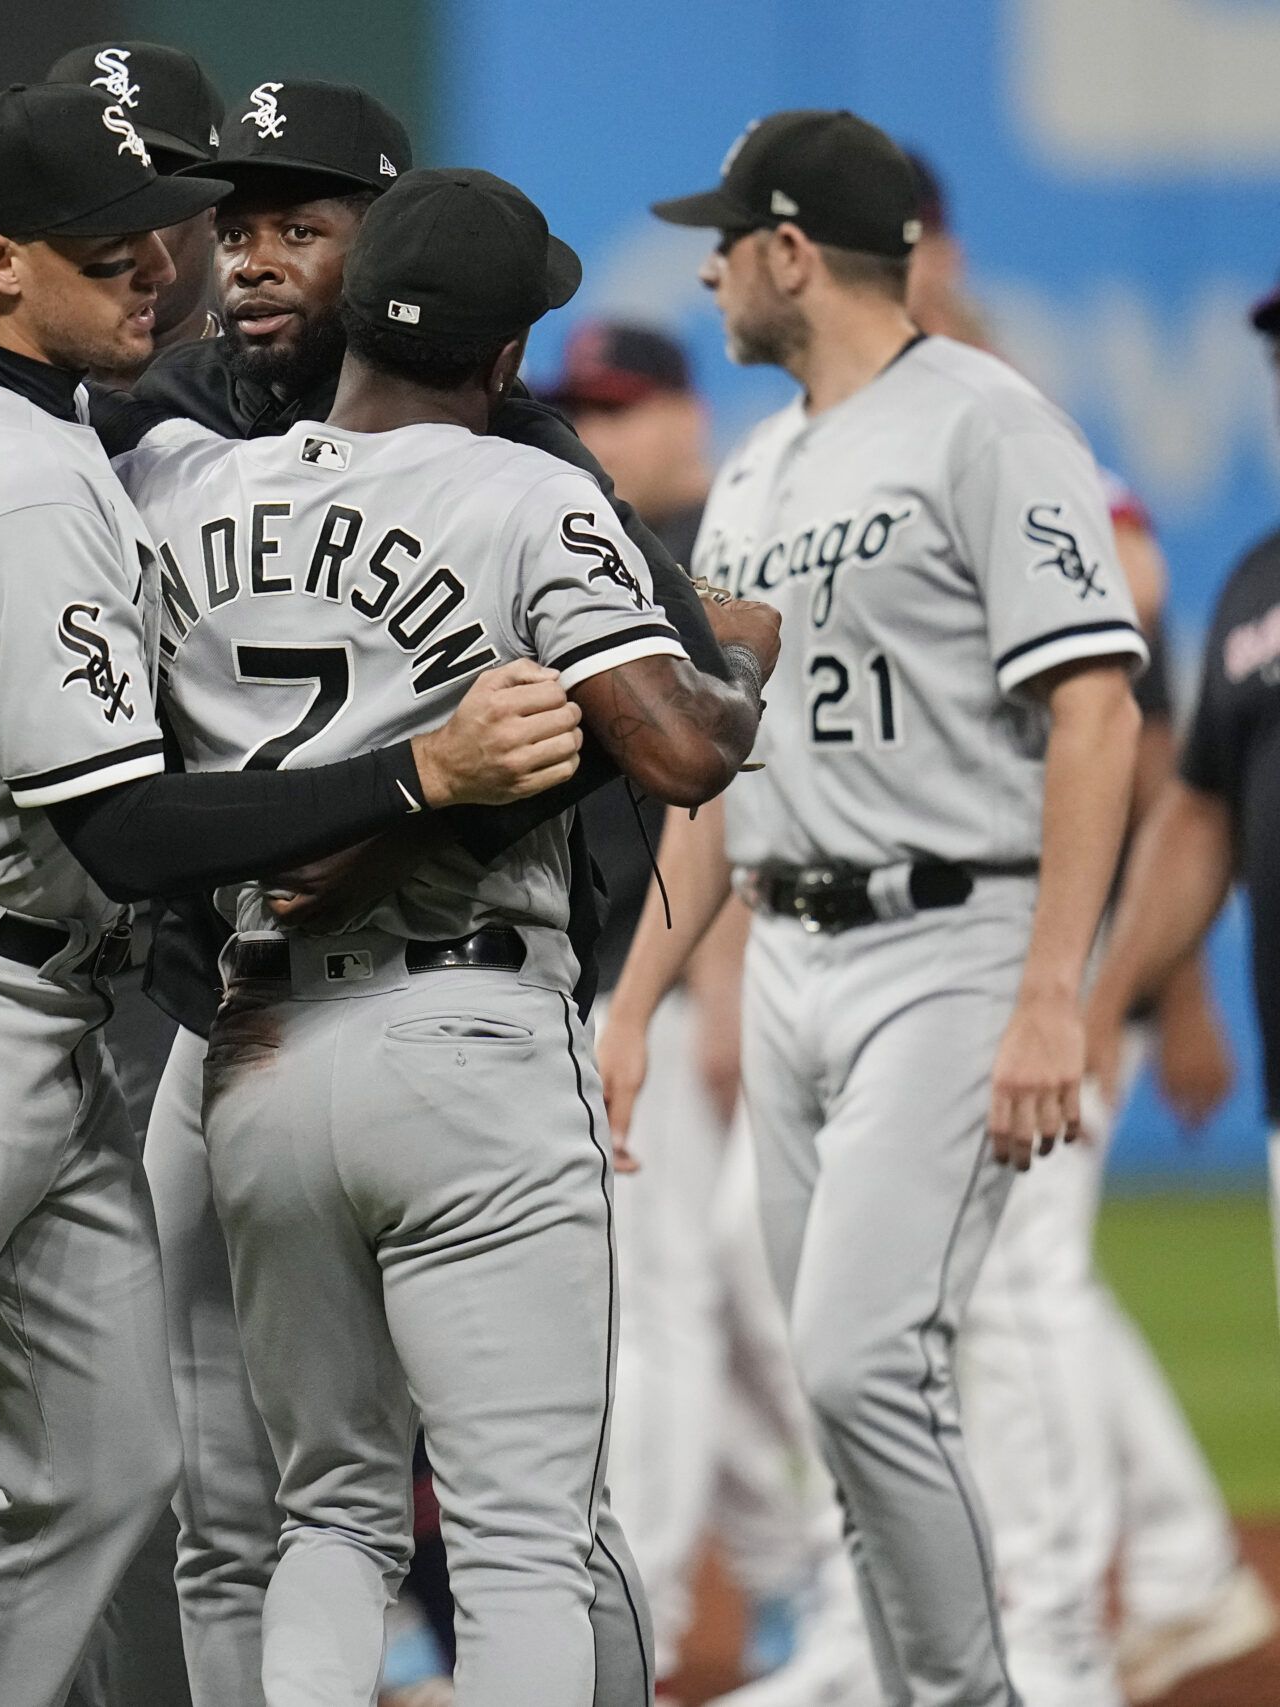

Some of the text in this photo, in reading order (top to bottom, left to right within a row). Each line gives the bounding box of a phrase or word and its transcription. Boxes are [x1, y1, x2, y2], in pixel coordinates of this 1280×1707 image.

[157, 500, 501, 698] NDERSON
[56, 601, 136, 726] Sox
[231, 639, 355, 771] 7
[809, 654, 896, 742] 21
